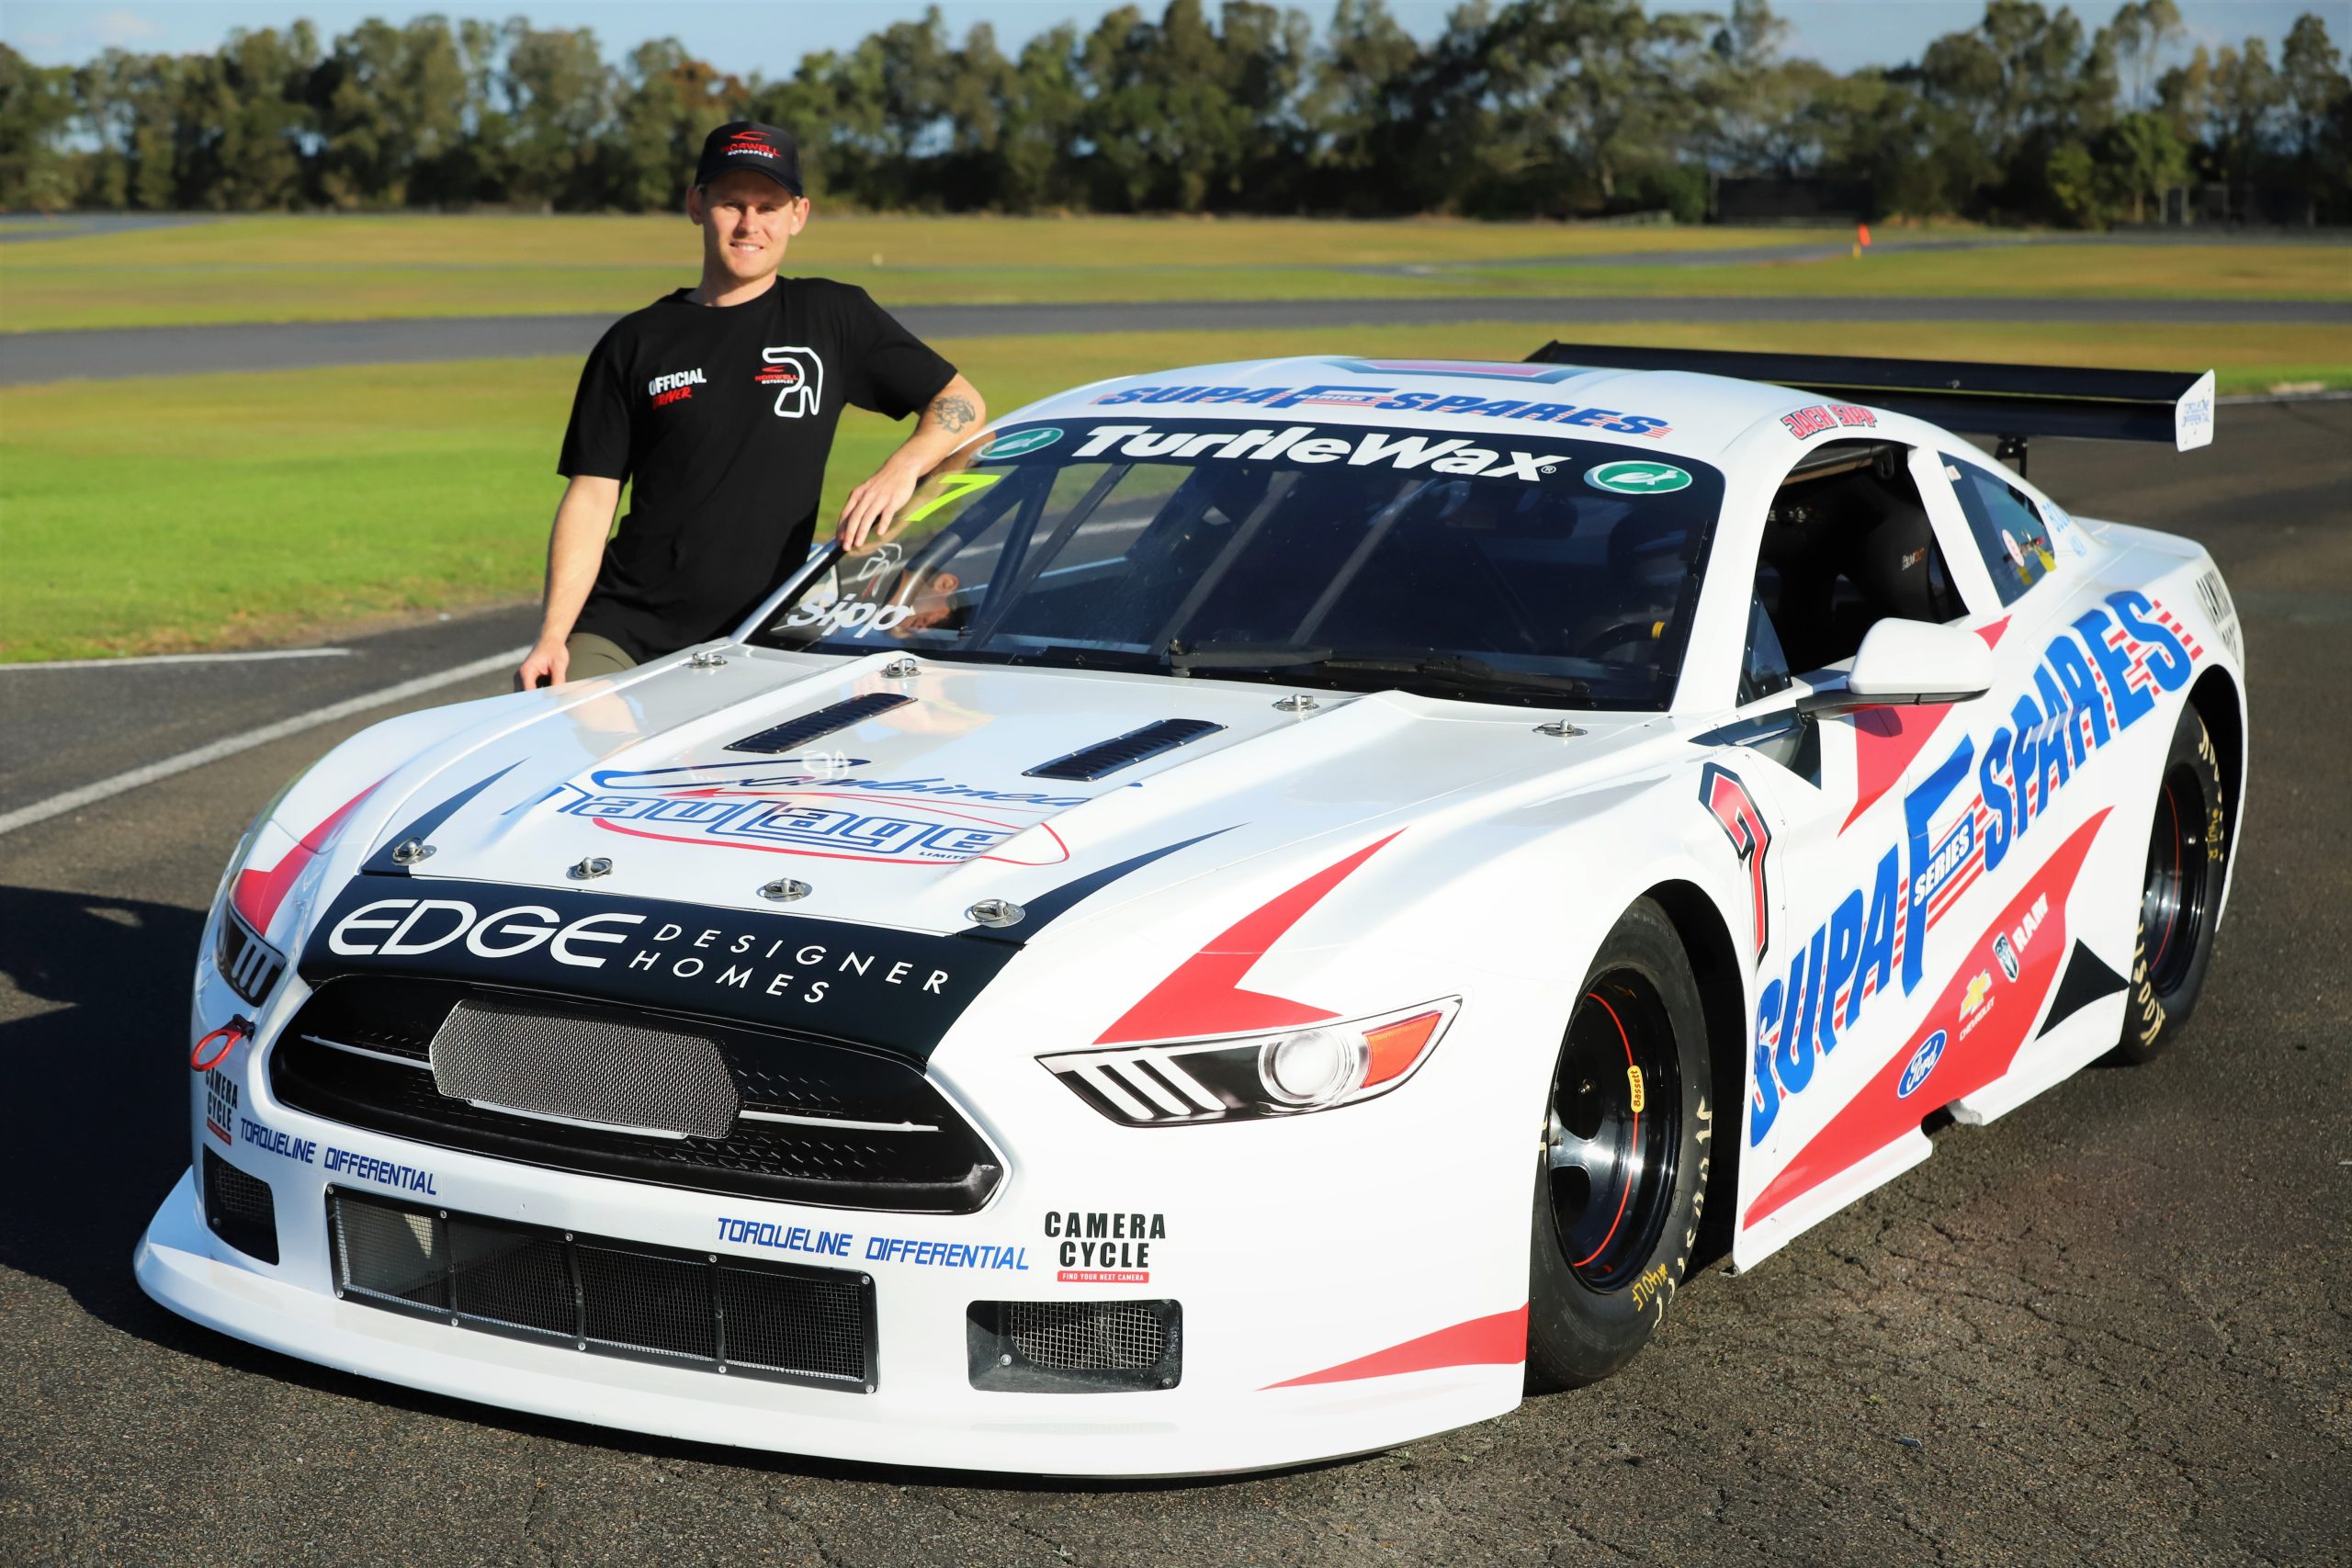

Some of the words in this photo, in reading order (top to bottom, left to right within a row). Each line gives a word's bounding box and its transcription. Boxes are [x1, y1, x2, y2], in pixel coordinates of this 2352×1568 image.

[649, 367, 707, 397] OFFICIAL
[652, 387, 693, 410] DRIVER
[1374, 392, 1670, 436] SPARES
[1781, 405, 1838, 440] JACK
[906, 474, 1001, 522] 7
[1914, 823, 1971, 908] SERIES
[1979, 589, 2193, 872] SPARES
[328, 898, 648, 968] EDGE
[2012, 891, 2049, 953] RAM
[628, 950, 830, 1004] HOMES
[653, 924, 950, 995] DESIGNER
[1959, 996, 1996, 1042] CHEVROLET
[1906, 1039, 1939, 1092] Ford
[206, 1067, 238, 1110] CAMERA
[1631, 1069, 1643, 1108] Bassett
[208, 1091, 232, 1132] CYCLE
[241, 1117, 315, 1165] TORQUELINE
[323, 1146, 437, 1196] DIFFERENTIAL
[718, 1217, 853, 1258] TORQUELINE
[865, 1236, 1030, 1270] DIFFERENTIAL
[1044, 1211, 1167, 1240] CAMERA
[1059, 1240, 1150, 1269] CYCLE
[1100, 1273, 1116, 1281] NEXT
[1118, 1273, 1144, 1281] CAMERA
